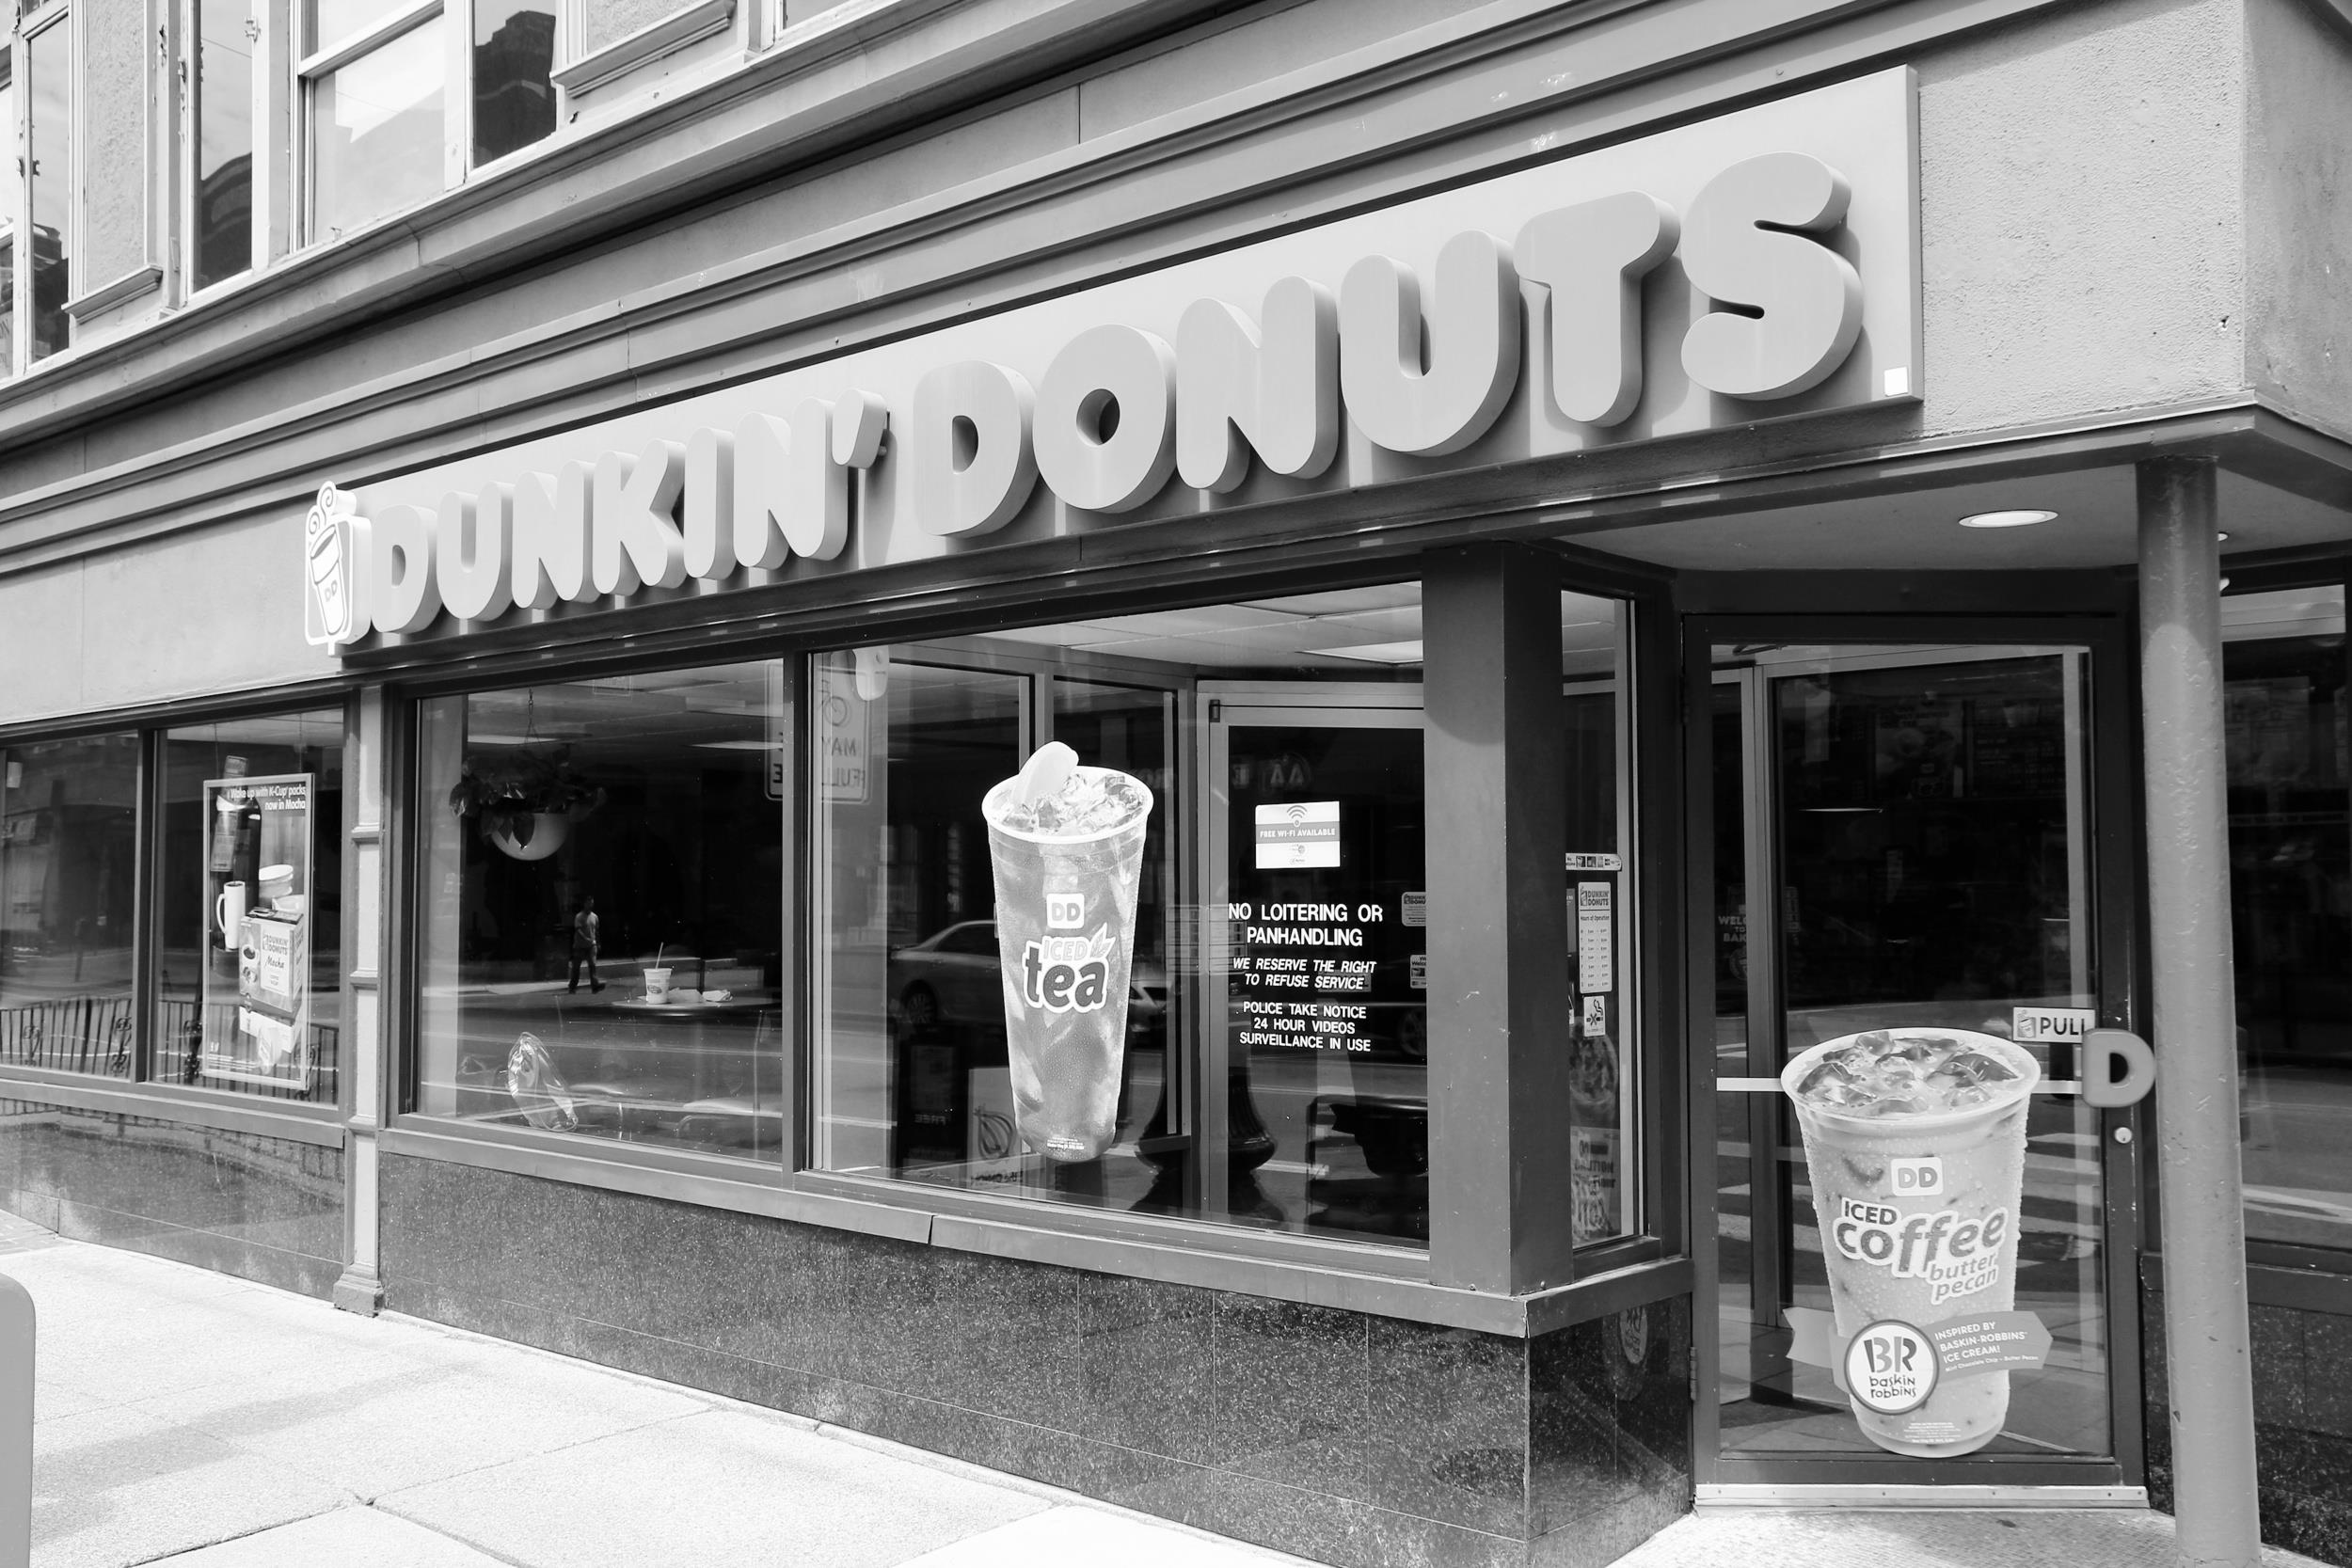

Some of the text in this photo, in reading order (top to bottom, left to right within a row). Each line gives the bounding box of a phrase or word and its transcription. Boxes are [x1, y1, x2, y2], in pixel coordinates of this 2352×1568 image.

[372, 150, 1863, 633] DUNKIN' DONUTS
[289, 784, 306, 798] packs
[265, 798, 306, 810] now in Mocha
[1297, 828, 1336, 836] AVAILABLE
[1051, 902, 1081, 922] DD
[1229, 903, 1251, 920] NO
[1262, 903, 1348, 922] LOITERING
[1358, 904, 1383, 922] OR
[1247, 927, 1363, 946] PANHANDLING
[1043, 939, 1089, 960] ICED
[1232, 958, 1377, 974] WE RESERVE THE RIGHT
[1025, 946, 1105, 1007] tea
[1245, 974, 1365, 990] TO REFUSE SERVICE
[1243, 1001, 1367, 1019] POLICE TAKE NOTICE
[1254, 1017, 1356, 1035] 24 HOUR VIDEOS
[1239, 1032, 1372, 1053] SURVEILLANCE IN USE
[1898, 1166, 1938, 1189] DD
[1844, 1200, 1898, 1226] ICED
[1836, 1212, 2005, 1273] coffee
[1930, 1254, 1997, 1281] butter
[1935, 1268, 1997, 1301] pecan
[1934, 1321, 1995, 1340] INSPIRED BY
[1864, 1336, 1917, 1373] BR
[1943, 1345, 2001, 1364] ICE CREAM!
